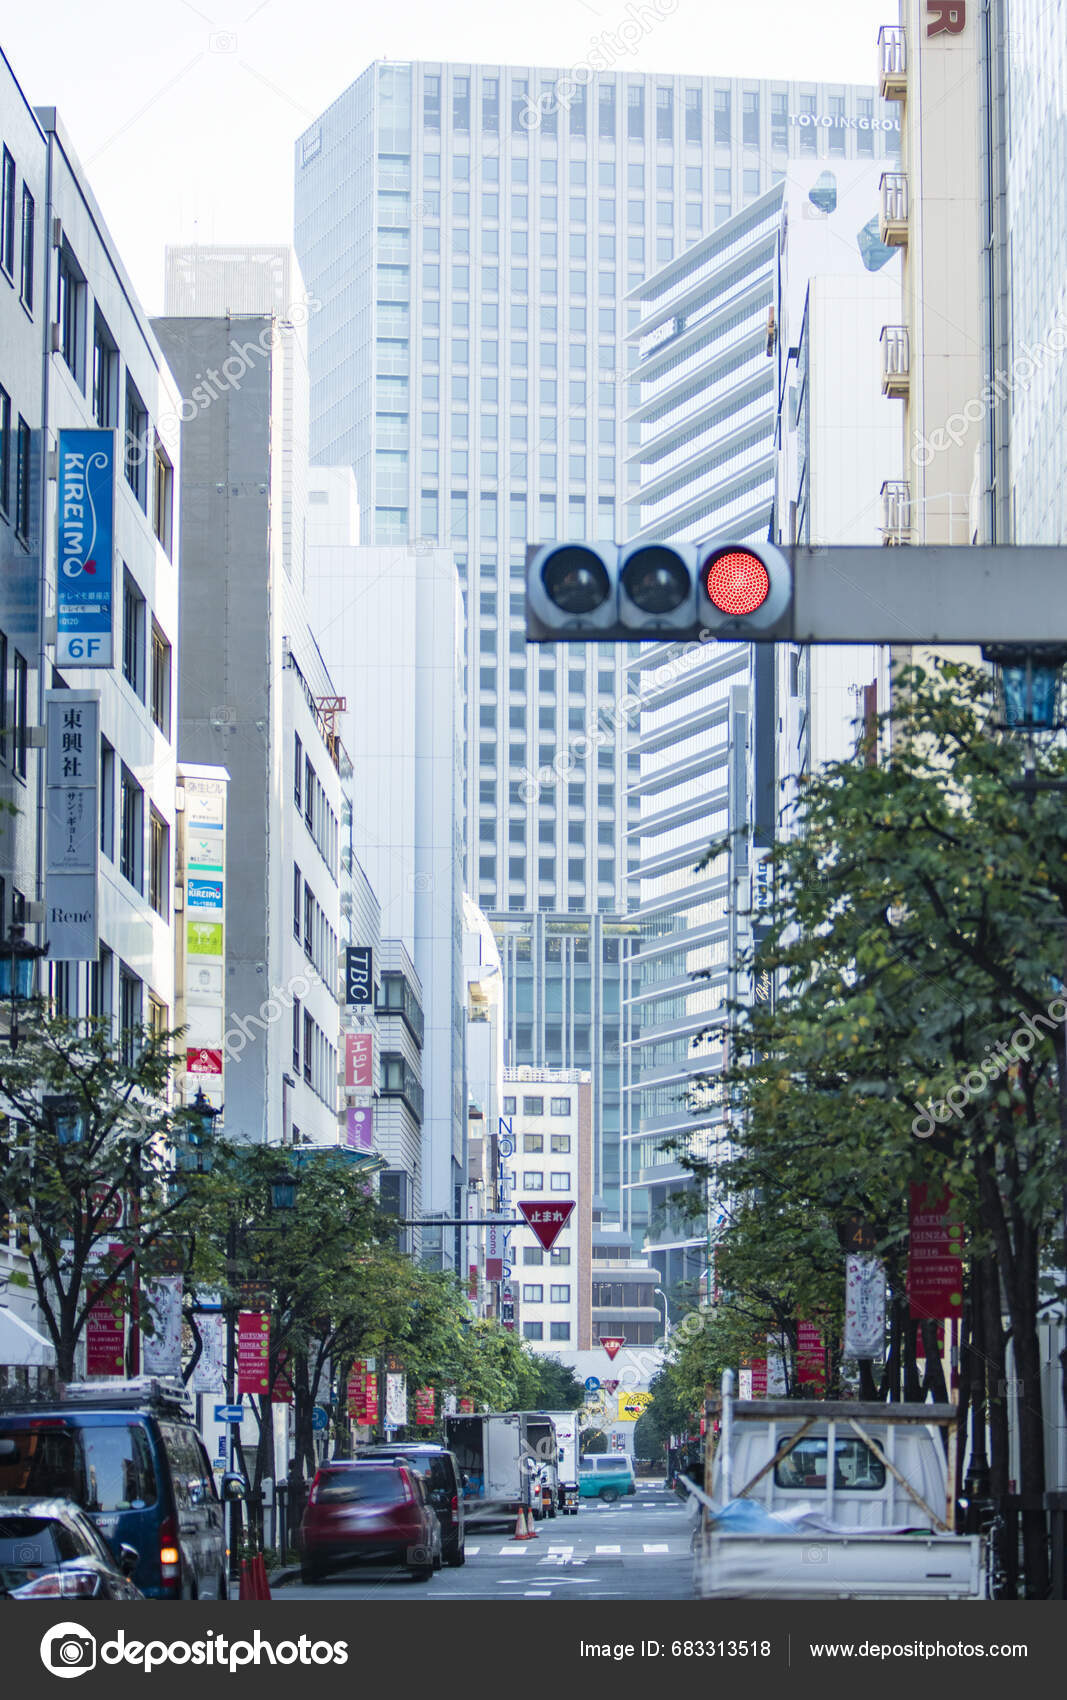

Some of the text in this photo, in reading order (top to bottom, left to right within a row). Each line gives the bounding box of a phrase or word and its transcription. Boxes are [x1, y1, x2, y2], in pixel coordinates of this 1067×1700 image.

[63, 453, 84, 578] KIREIMO
[68, 638, 101, 658] 6F
[63, 708, 82, 777] 東興社
[188, 889, 221, 900] KIREIMO
[51, 907, 92, 923] René
[350, 951, 368, 1000] TBC
[352, 1040, 367, 1084] エピレ
[530, 1211, 564, 1223] 止まれ
[912, 1231, 948, 1240] GINZA
